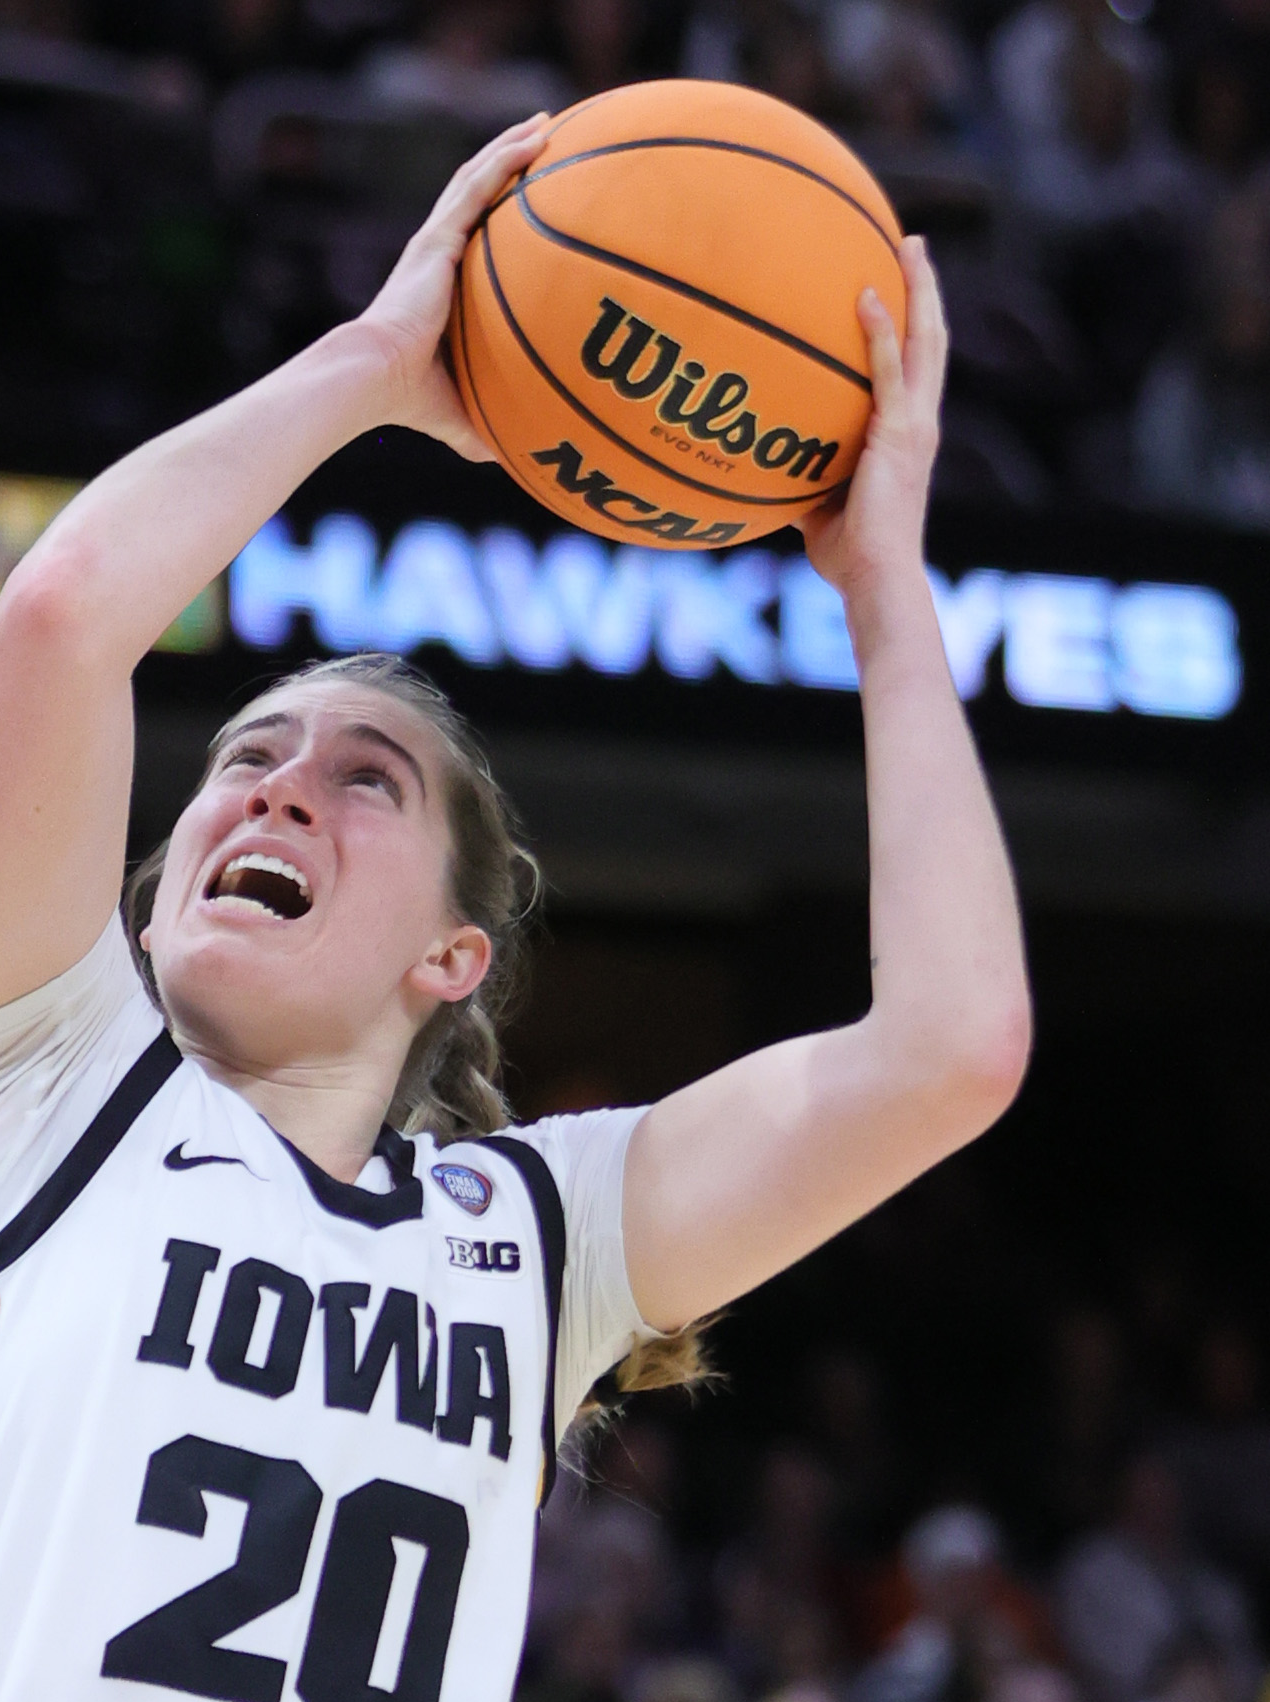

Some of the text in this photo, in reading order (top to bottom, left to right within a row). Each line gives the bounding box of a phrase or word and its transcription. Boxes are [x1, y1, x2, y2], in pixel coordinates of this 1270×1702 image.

[581, 297, 839, 483] Wilson
[650, 425, 735, 473] EVO NXT
[529, 440, 747, 543] NCAA
[136, 1238, 514, 1462] IOWA
